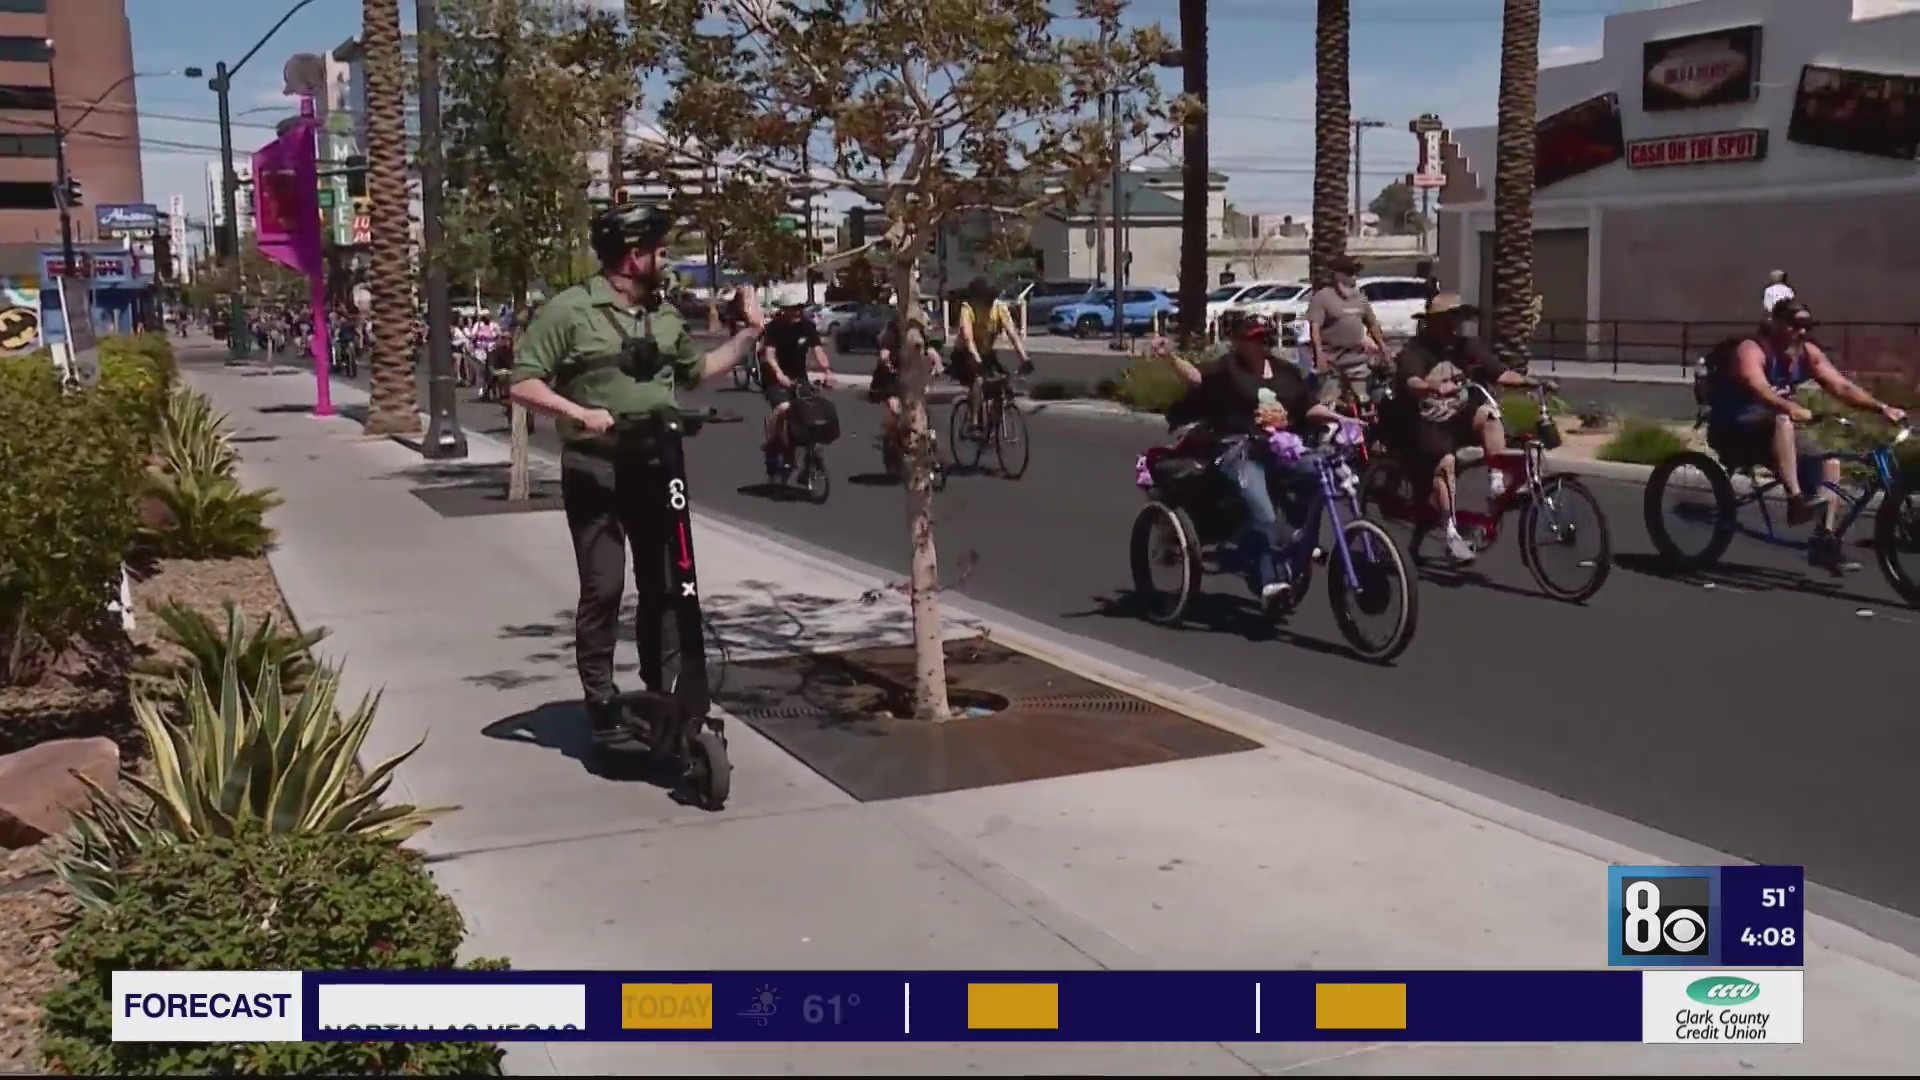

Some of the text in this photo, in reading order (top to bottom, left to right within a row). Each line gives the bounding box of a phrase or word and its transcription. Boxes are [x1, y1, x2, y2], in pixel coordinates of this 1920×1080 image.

[1630, 133, 1756, 164] CASH ON THE SPOT
[669, 478, 686, 510] GO
